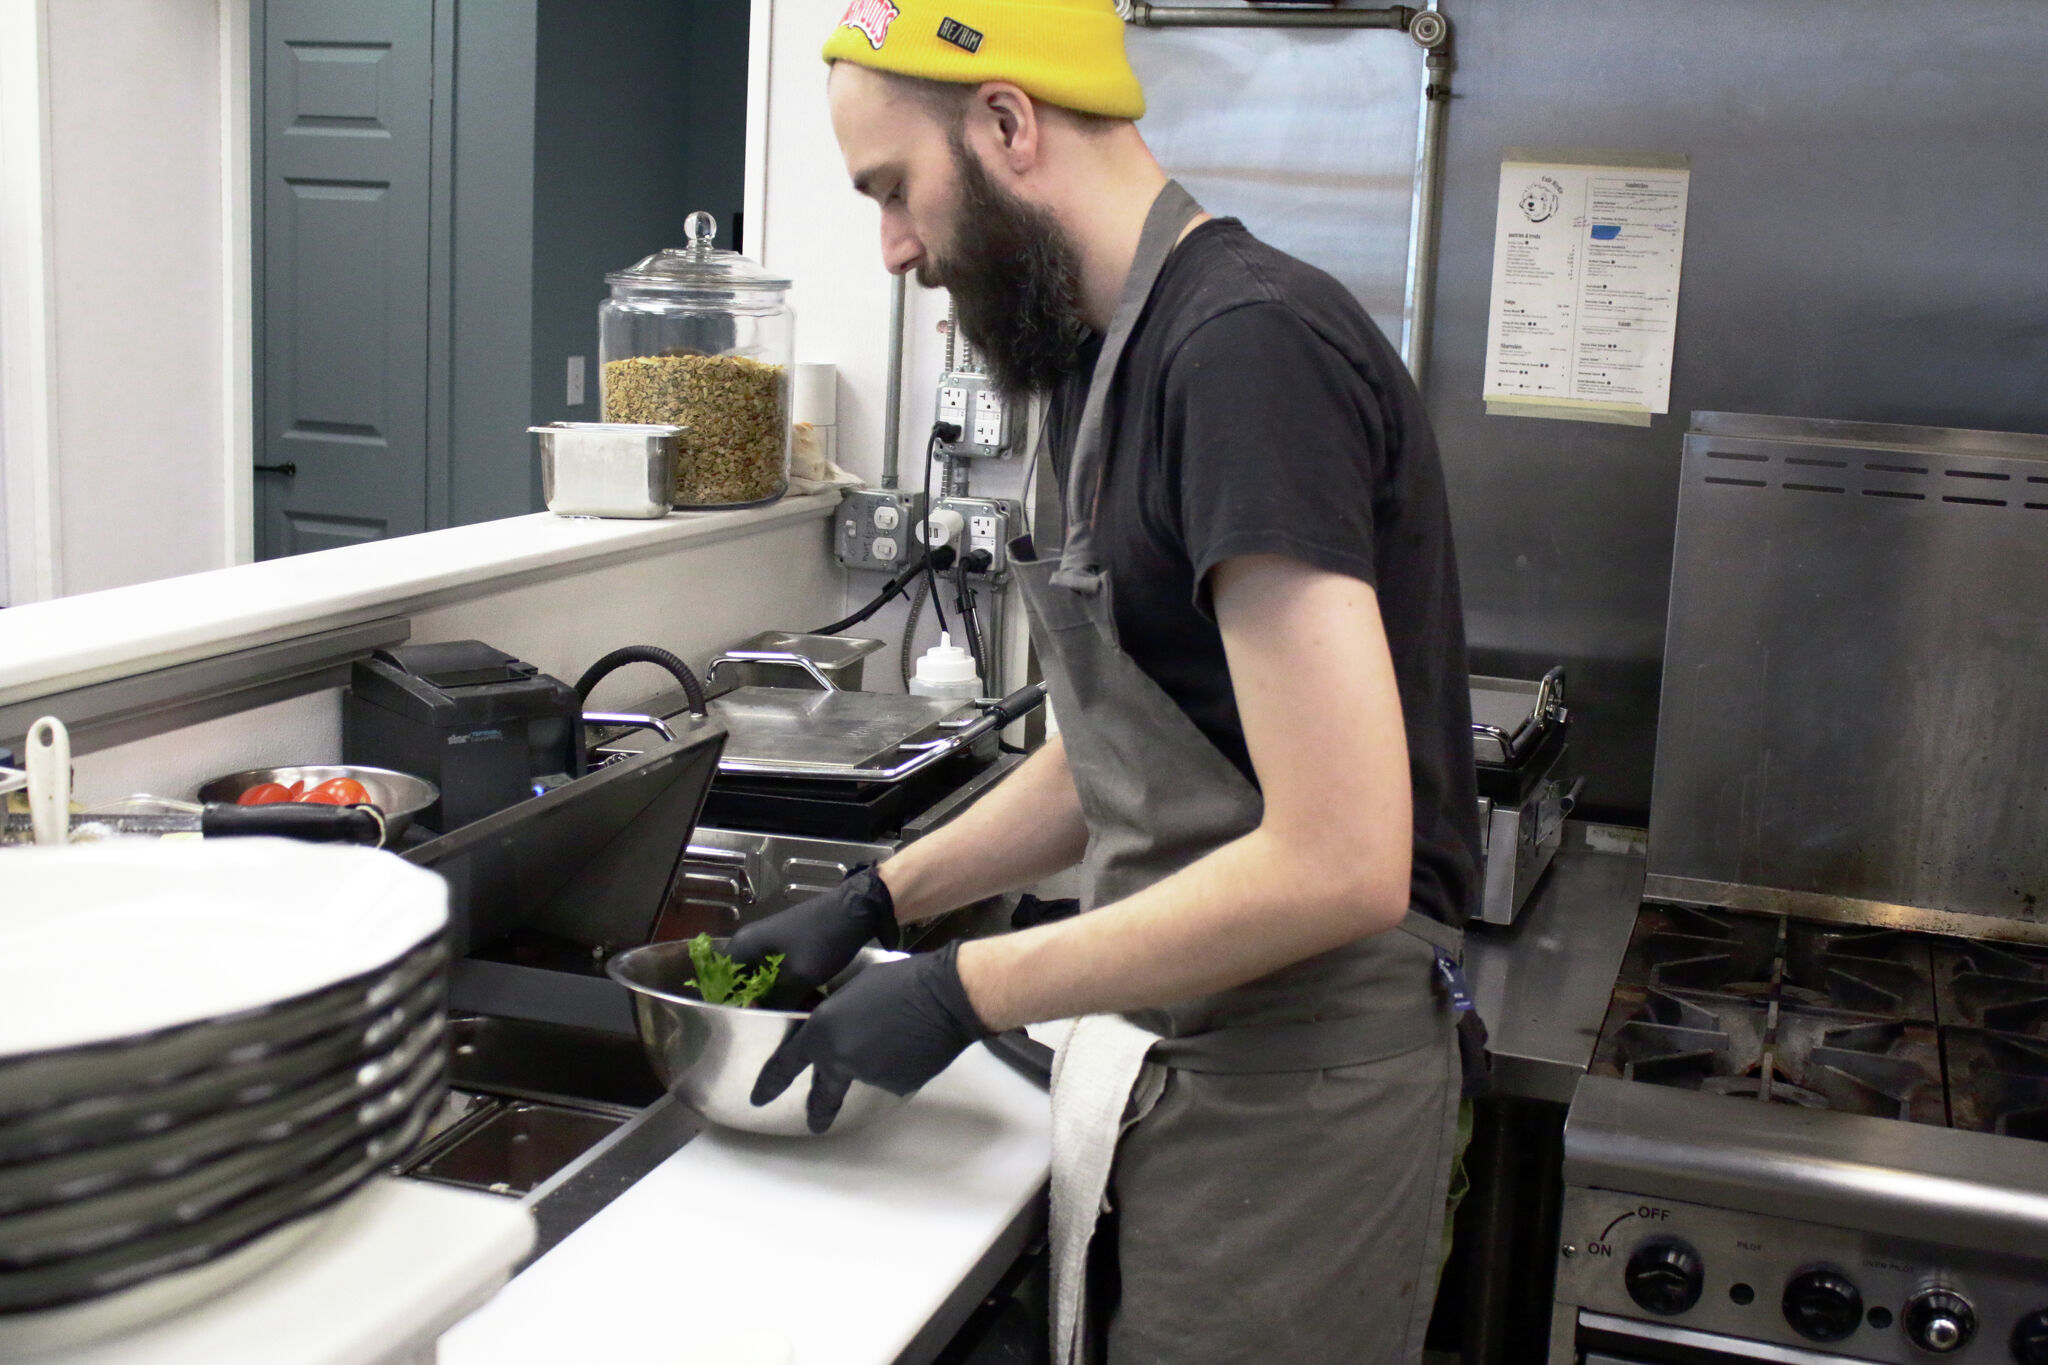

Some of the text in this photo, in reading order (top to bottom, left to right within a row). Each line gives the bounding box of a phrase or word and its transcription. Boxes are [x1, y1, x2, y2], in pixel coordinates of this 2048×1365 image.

[940, 19, 980, 50] HE/HIM
[1638, 1206, 1671, 1221] OFF
[1588, 1242, 1612, 1257] ON
